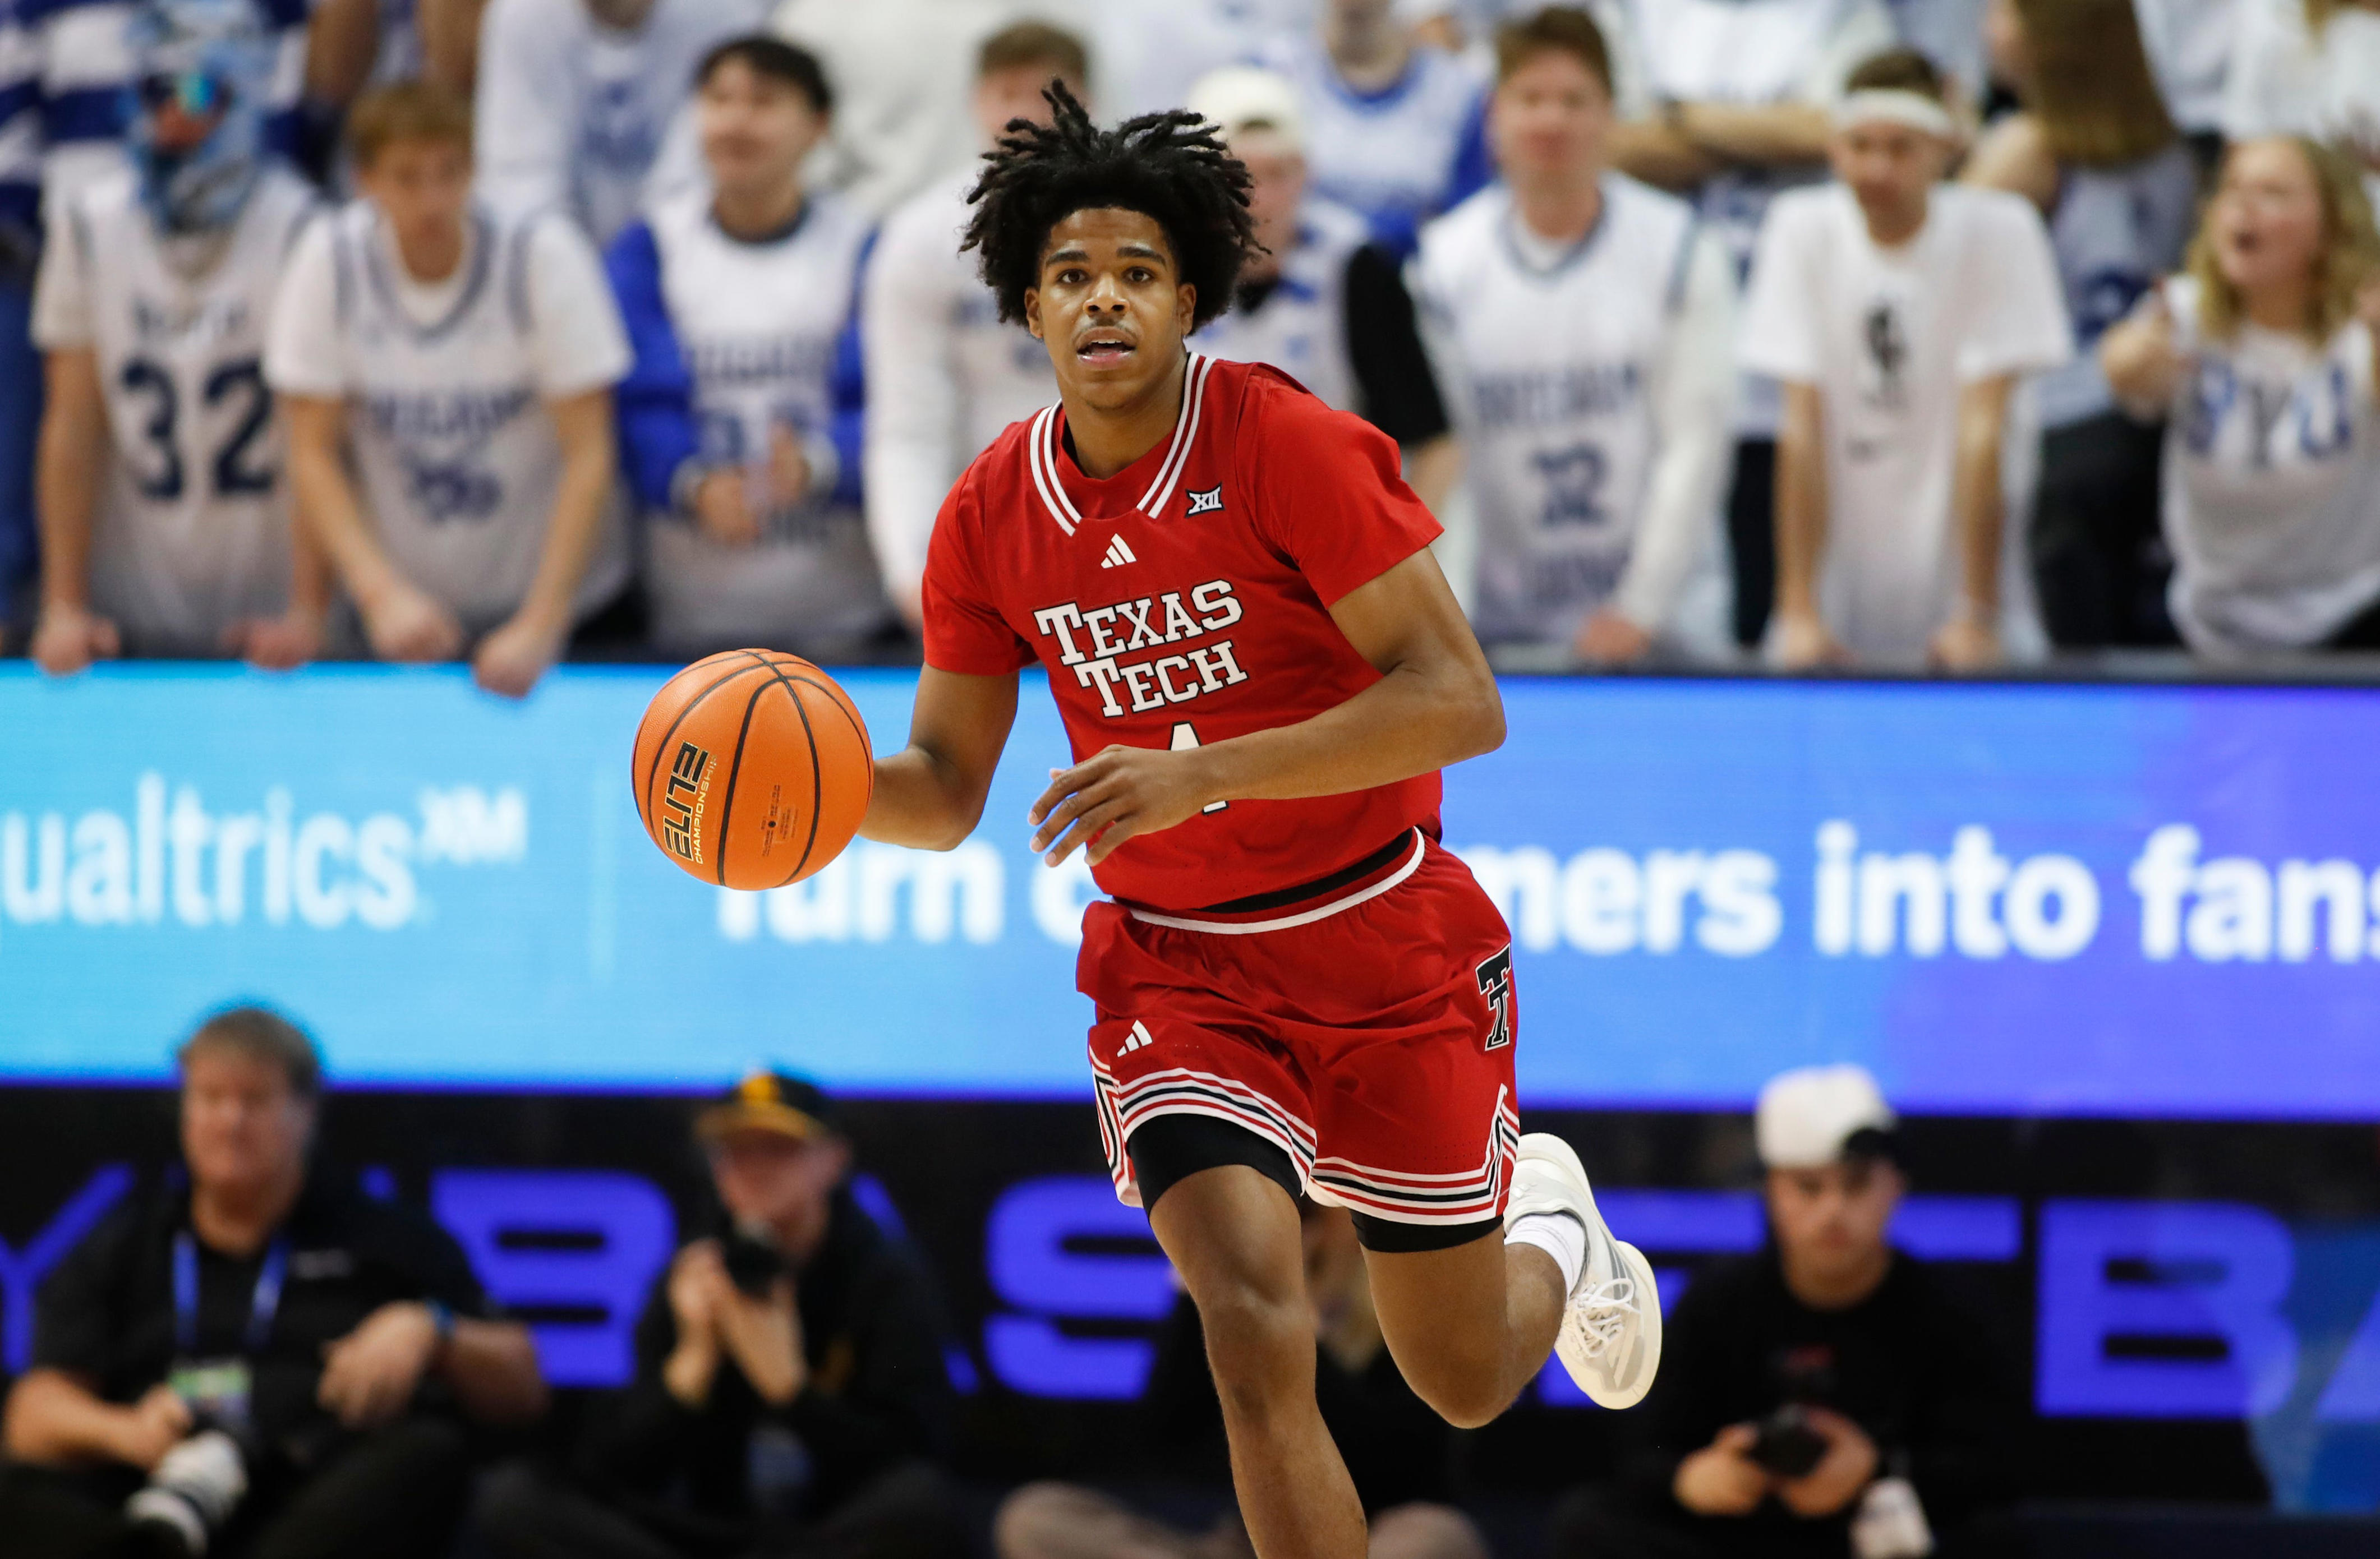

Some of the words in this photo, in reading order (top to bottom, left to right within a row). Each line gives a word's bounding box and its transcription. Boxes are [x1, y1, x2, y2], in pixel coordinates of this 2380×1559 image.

[120, 358, 277, 501] 32
[1033, 579, 1243, 666] TEXAS
[1072, 639, 1249, 718] TECH
[663, 740, 709, 862] ELITE
[1815, 818, 2100, 960] into
[2128, 822, 2380, 966] fan
